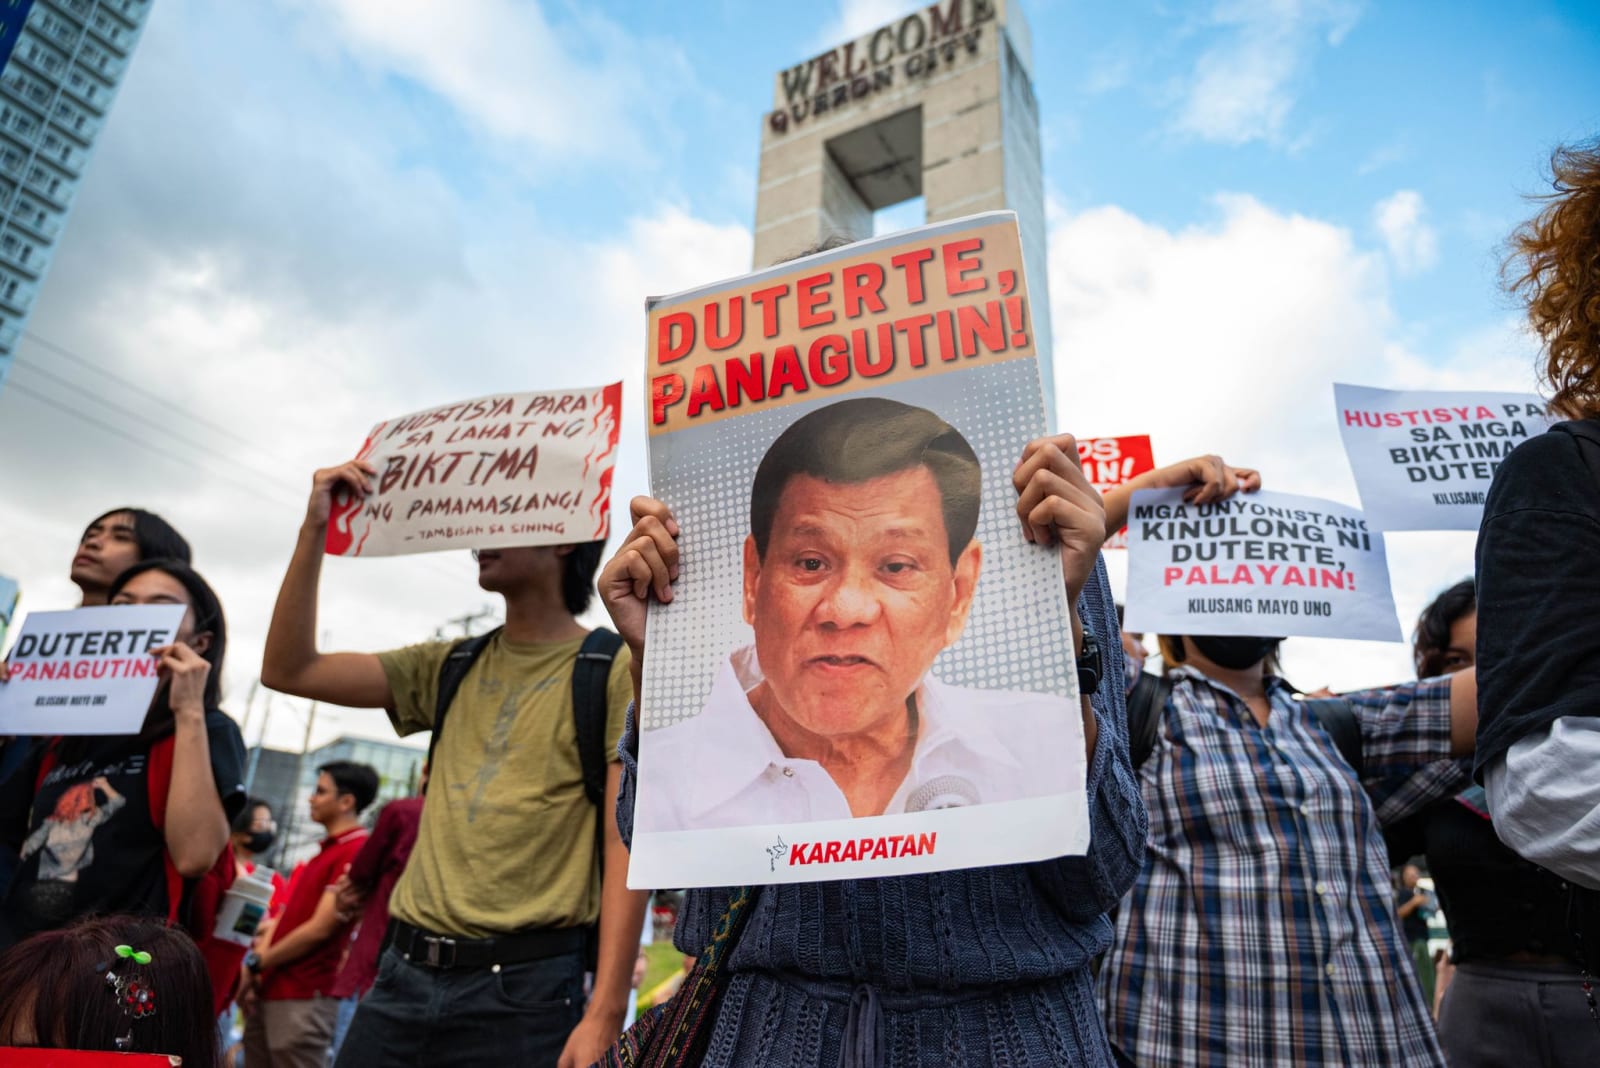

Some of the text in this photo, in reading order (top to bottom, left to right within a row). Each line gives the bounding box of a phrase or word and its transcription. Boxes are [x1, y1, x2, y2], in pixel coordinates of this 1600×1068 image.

[780, 0, 995, 102] WELCOME
[905, 28, 982, 78] CITY
[657, 238, 1017, 364] DUTERTE,
[651, 296, 1028, 426] PANAGUTIN!
[522, 394, 587, 417] PARA
[1344, 403, 1548, 429] HUSTISYA PA
[397, 418, 586, 449] SA LAHAT NG
[1410, 420, 1528, 443] SA MGA
[1389, 440, 1516, 464] BIKTIMA
[378, 444, 538, 495] BIKTIMA
[1083, 457, 1135, 485] IN!
[364, 490, 582, 523] NG PAMAMASLANG!
[1135, 504, 1188, 519] MGA
[1432, 491, 1486, 505] KILUSANG
[511, 522, 566, 535] SINING
[1142, 518, 1325, 543] KINULONG
[1337, 529, 1372, 551] NI
[1171, 541, 1346, 571] DUTERTE,
[1163, 564, 1357, 591] PALAYAIN!
[1188, 598, 1332, 617] KILUSANG MAYO UNO
[789, 832, 937, 866] KARAPATAN
